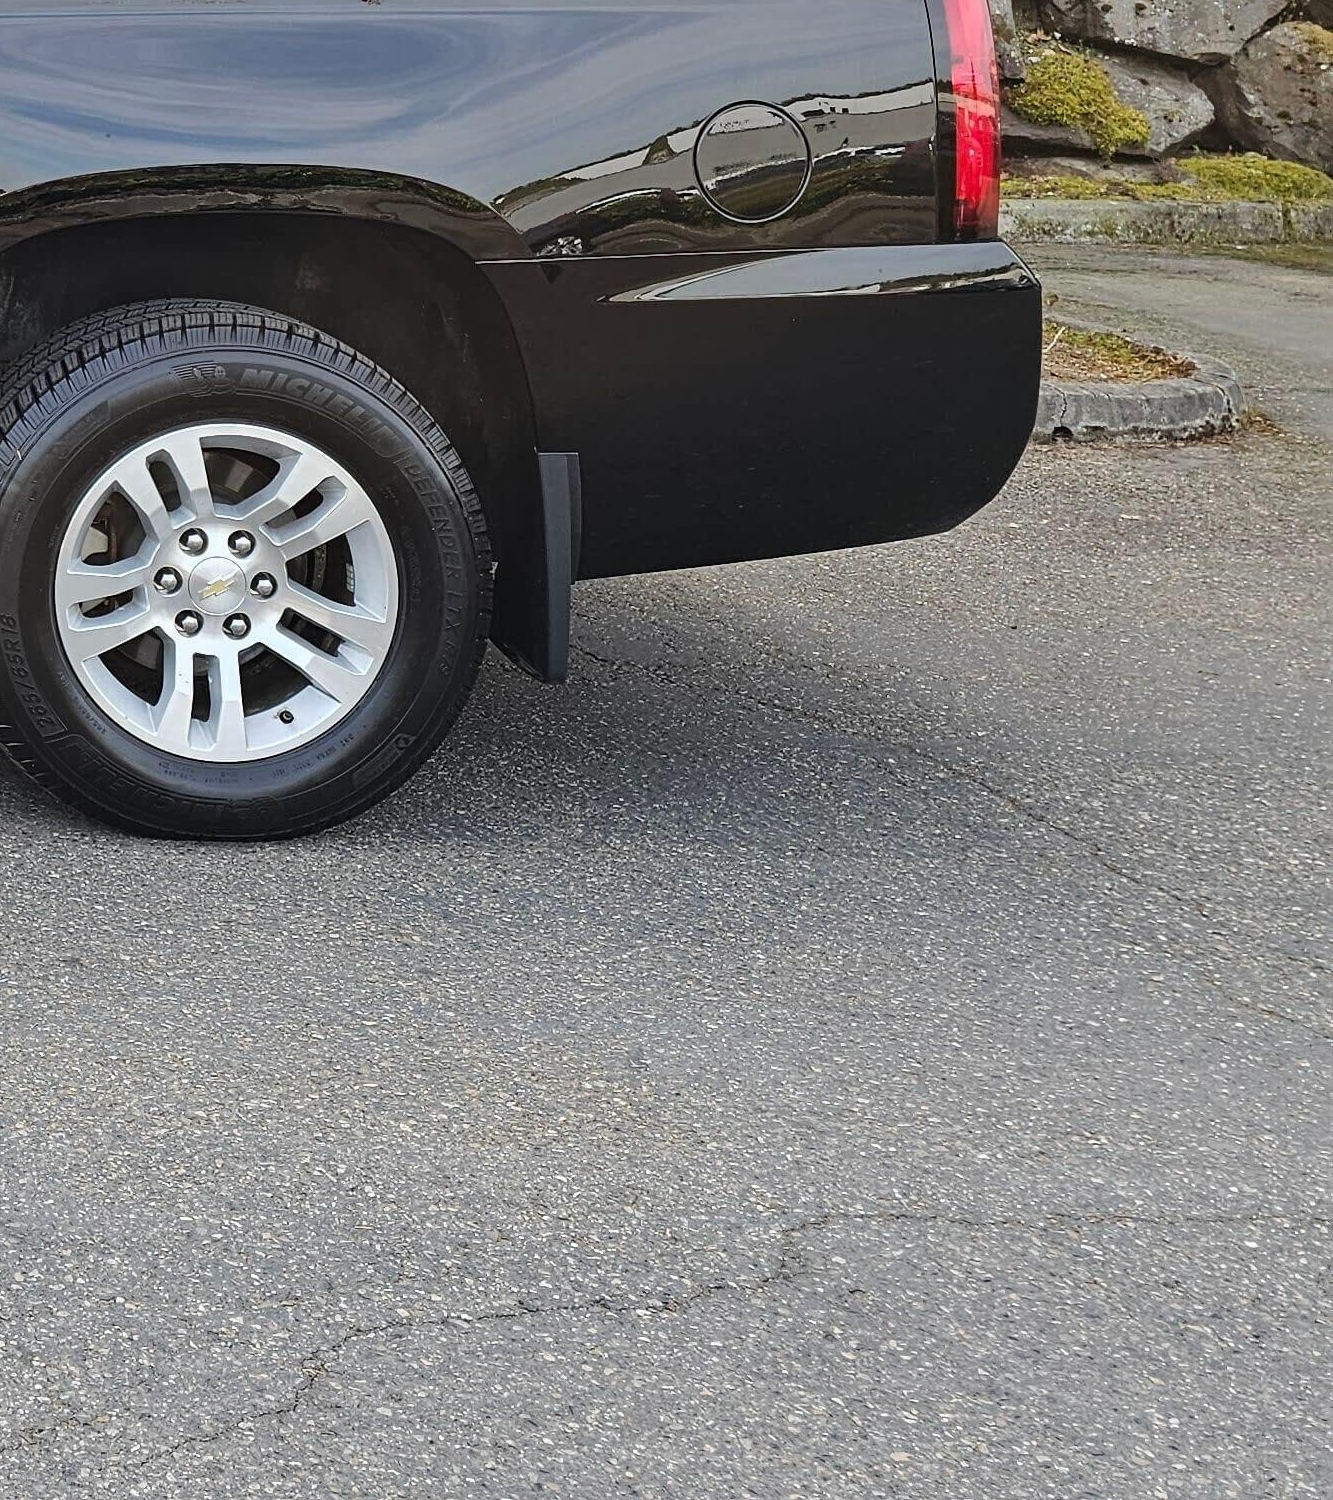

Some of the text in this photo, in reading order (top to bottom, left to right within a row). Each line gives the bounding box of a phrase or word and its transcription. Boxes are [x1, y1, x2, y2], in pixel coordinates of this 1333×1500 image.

[240, 368, 402, 454] MICHELIN
[404, 461, 462, 579] DEFENDER
[0, 612, 58, 729] 265/65R18
